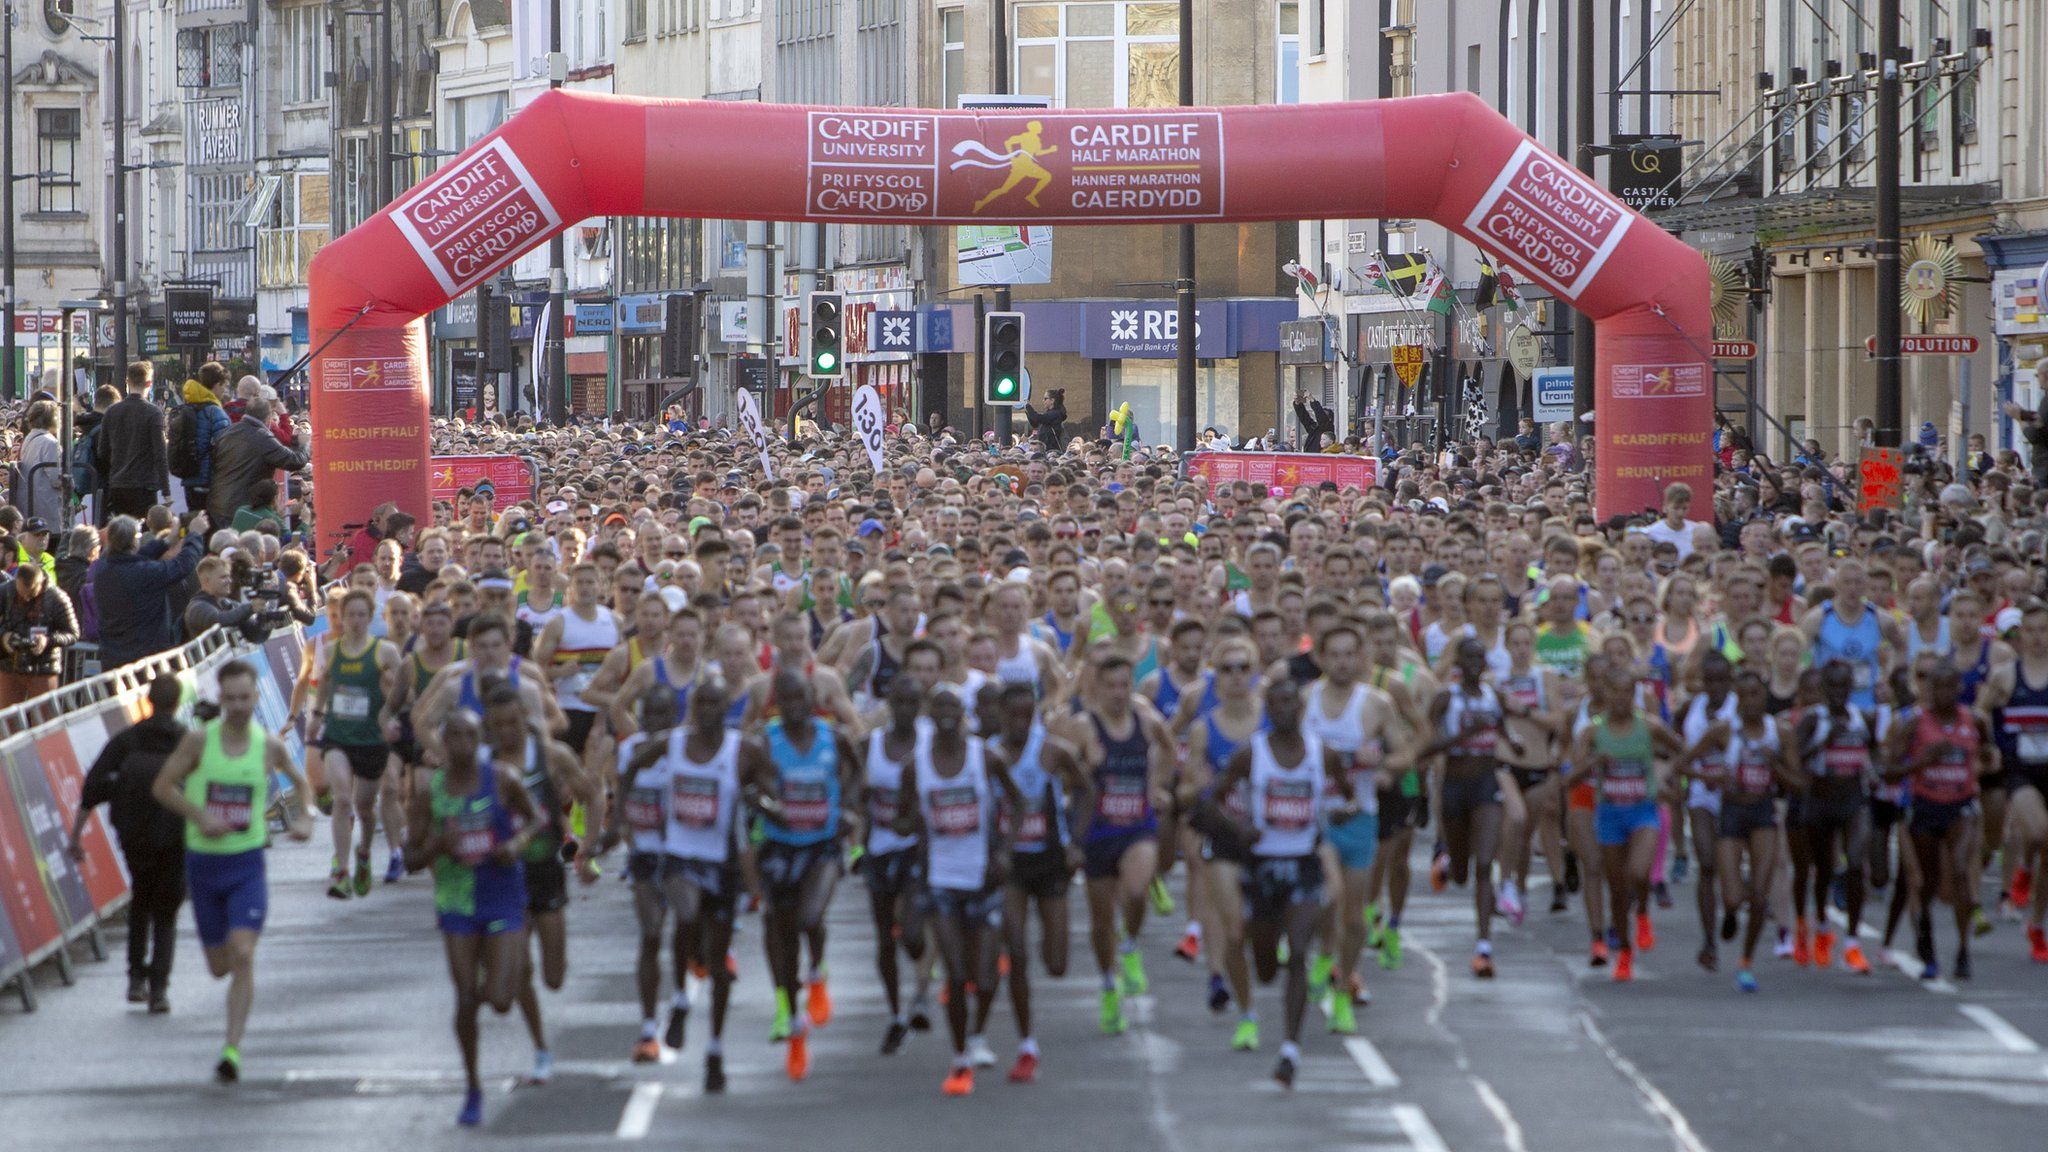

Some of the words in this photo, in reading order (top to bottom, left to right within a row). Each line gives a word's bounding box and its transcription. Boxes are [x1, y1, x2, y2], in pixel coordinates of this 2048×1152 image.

[199, 104, 240, 131] RUMMER
[818, 117, 929, 141] CARDIFF
[1070, 123, 1200, 147] CARDIFF
[201, 133, 238, 160] TAVERN
[822, 142, 927, 158] UNIVERSITY
[1071, 149, 1112, 163] HALF
[1115, 147, 1200, 162] MARATHON
[413, 153, 498, 224] CARDIFF
[821, 173, 925, 189] PRIFYSGOL
[1071, 174, 1126, 187] HANNER
[1129, 173, 1201, 186] MARATHON
[816, 188, 929, 213] CAERDYDD
[1071, 188, 1201, 209] CAERDYDD
[1526, 159, 1617, 225] CARDIFF
[428, 175, 510, 237] UNIVERSITY
[1519, 178, 1602, 238] UNIVERSITY
[445, 200, 527, 260] PRIFYSGOL
[1502, 200, 1582, 262] PRIFYSGOL
[452, 210, 538, 278] CAERDYDD
[1487, 213, 1577, 279] CAERDYDD
[23, 317, 86, 332] SPR
[172, 310, 206, 318] RUMMER
[577, 318, 611, 327] NERO
[1111, 343, 1123, 351] The
[1124, 343, 1143, 353] Royal
[1144, 343, 1161, 351] Bank
[1162, 343, 1171, 353] of
[1900, 339, 1971, 351] VOLUTION
[325, 426, 421, 440] #CARDIFFHALF
[855, 393, 882, 453] 1:30
[1612, 431, 1707, 445] #CARDIFFHALF
[328, 458, 419, 473] #RUNTHEDIFF
[1616, 464, 1705, 478] #RUNTHEDIFF
